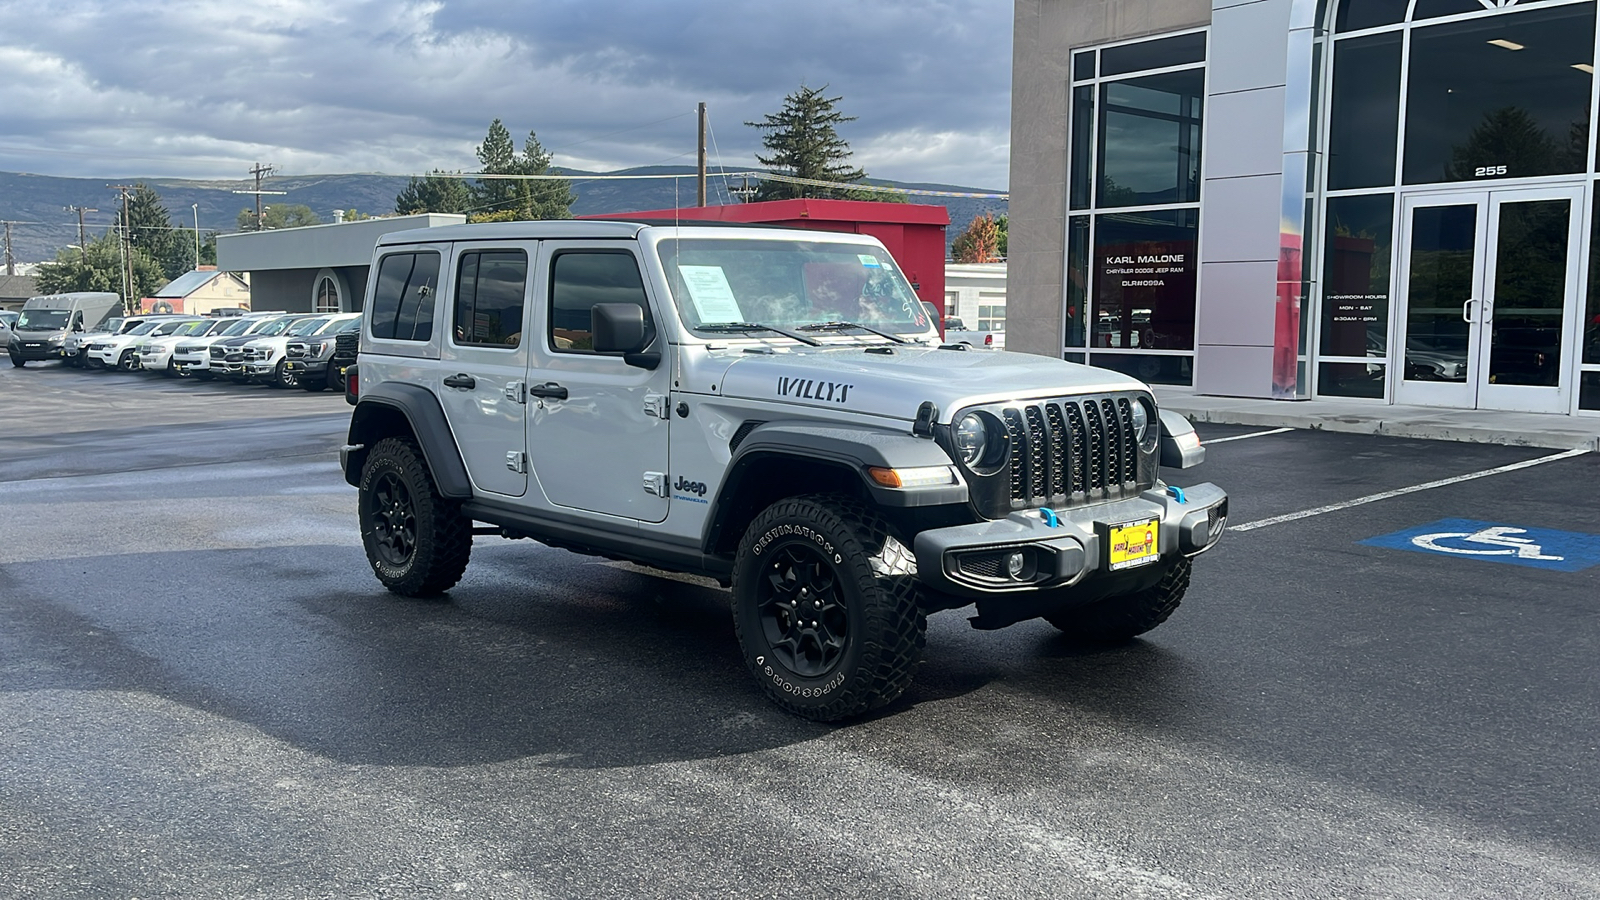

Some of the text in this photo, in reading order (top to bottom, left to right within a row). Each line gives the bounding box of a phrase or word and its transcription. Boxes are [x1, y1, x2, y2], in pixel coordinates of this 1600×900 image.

[1475, 165, 1507, 177] 255
[1106, 254, 1184, 264] KARL MALONE
[777, 376, 854, 403] WILLYS
[674, 475, 707, 497] Jeep
[753, 524, 834, 555] DESTINATION
